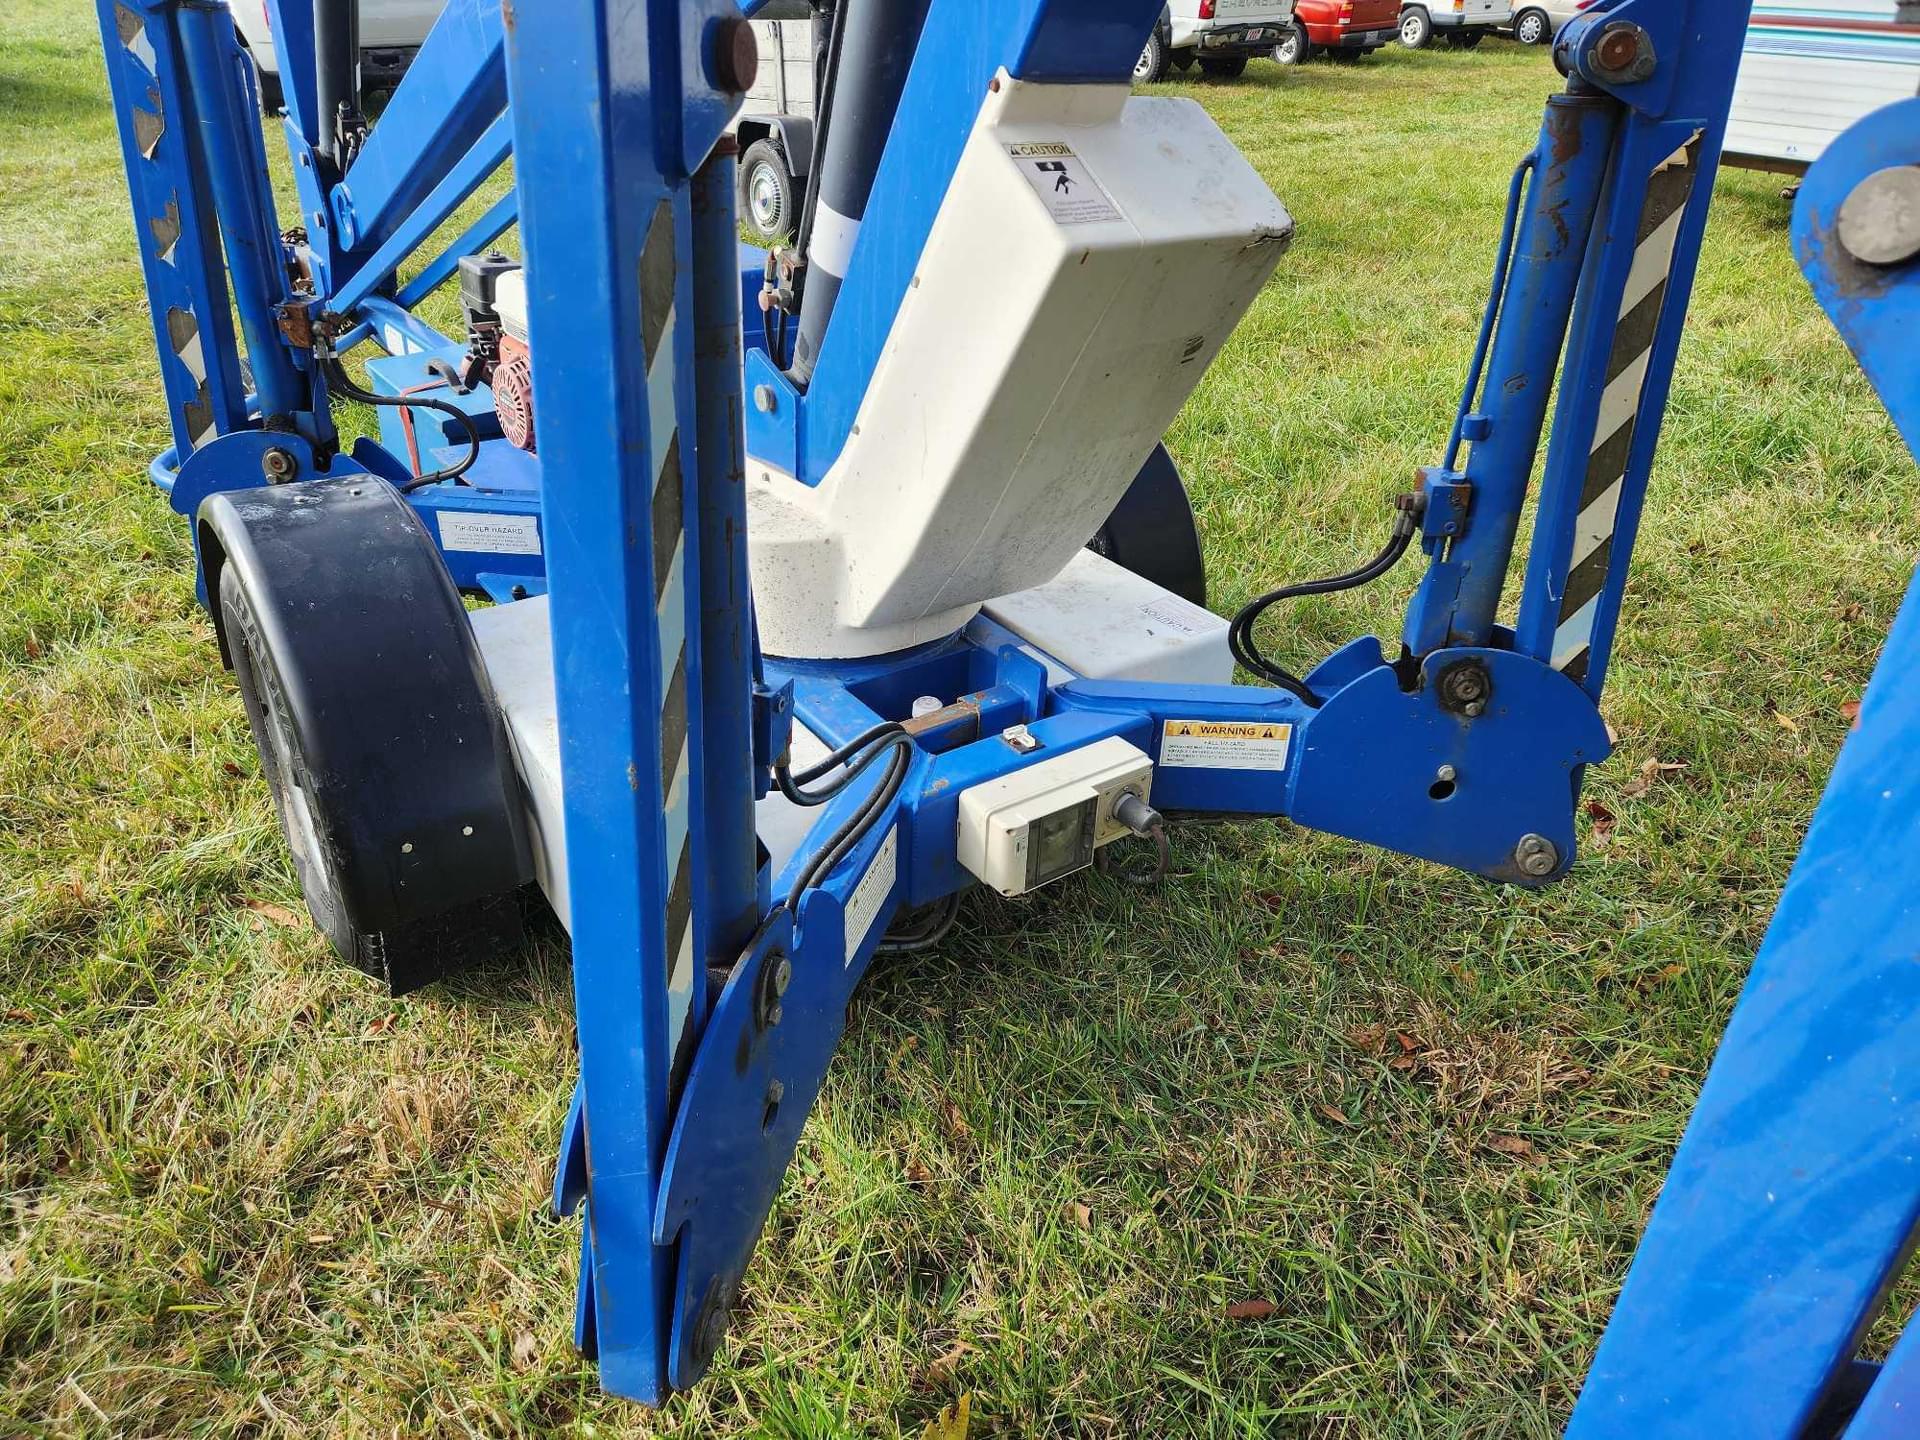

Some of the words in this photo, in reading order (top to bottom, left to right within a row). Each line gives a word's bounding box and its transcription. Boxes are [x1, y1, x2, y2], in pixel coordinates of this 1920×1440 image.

[1020, 144, 1072, 156] CAUTION
[455, 524, 490, 533] TIP-OVER
[1200, 726, 1256, 736] WARNING
